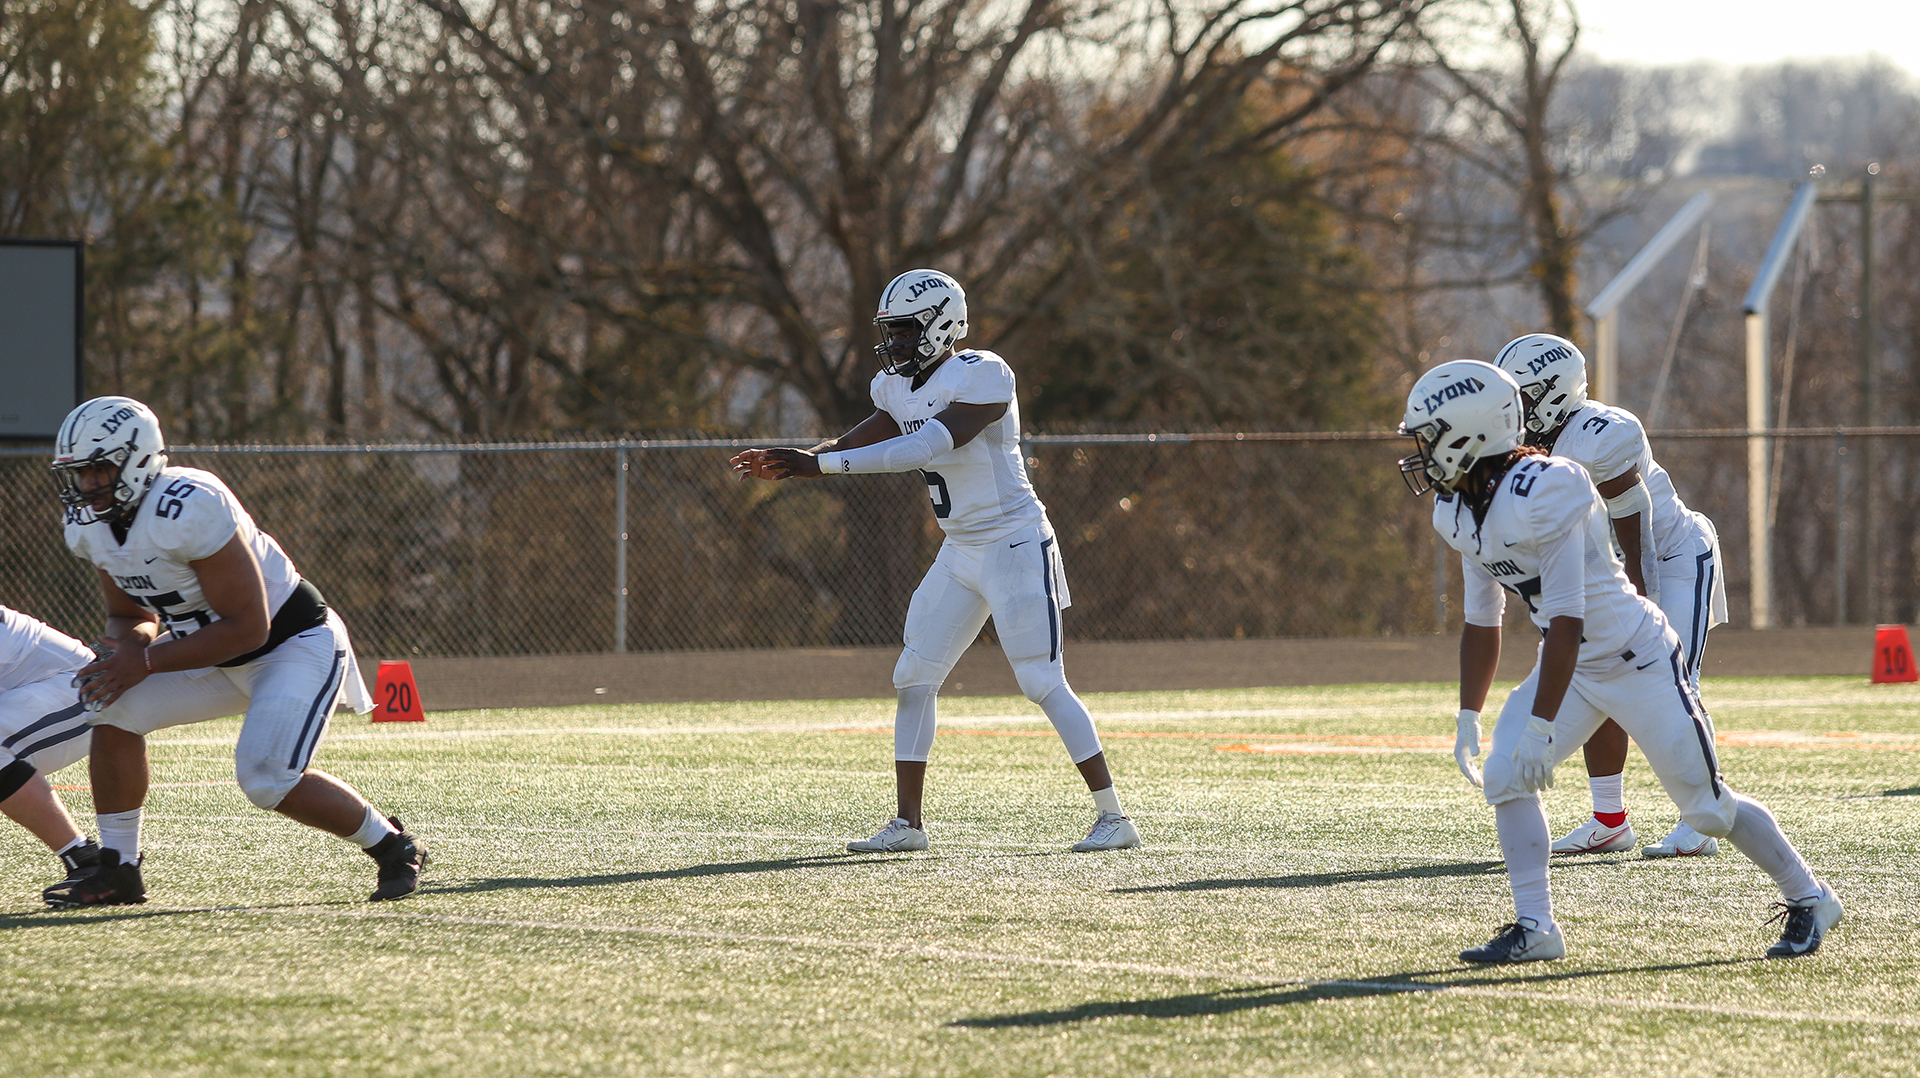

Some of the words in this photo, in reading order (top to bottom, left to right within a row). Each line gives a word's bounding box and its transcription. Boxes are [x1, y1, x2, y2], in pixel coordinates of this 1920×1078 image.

[909, 278, 950, 298] LYON
[959, 354, 984, 365] 5
[1527, 346, 1569, 376] LYON
[1424, 378, 1477, 416] LYON
[101, 406, 136, 435] LYON
[1582, 416, 1609, 435] 3
[155, 479, 196, 520] 55
[114, 575, 158, 590] LYON
[1481, 559, 1526, 577] LYON
[1882, 644, 1908, 676] 10
[385, 681, 412, 713] 20
